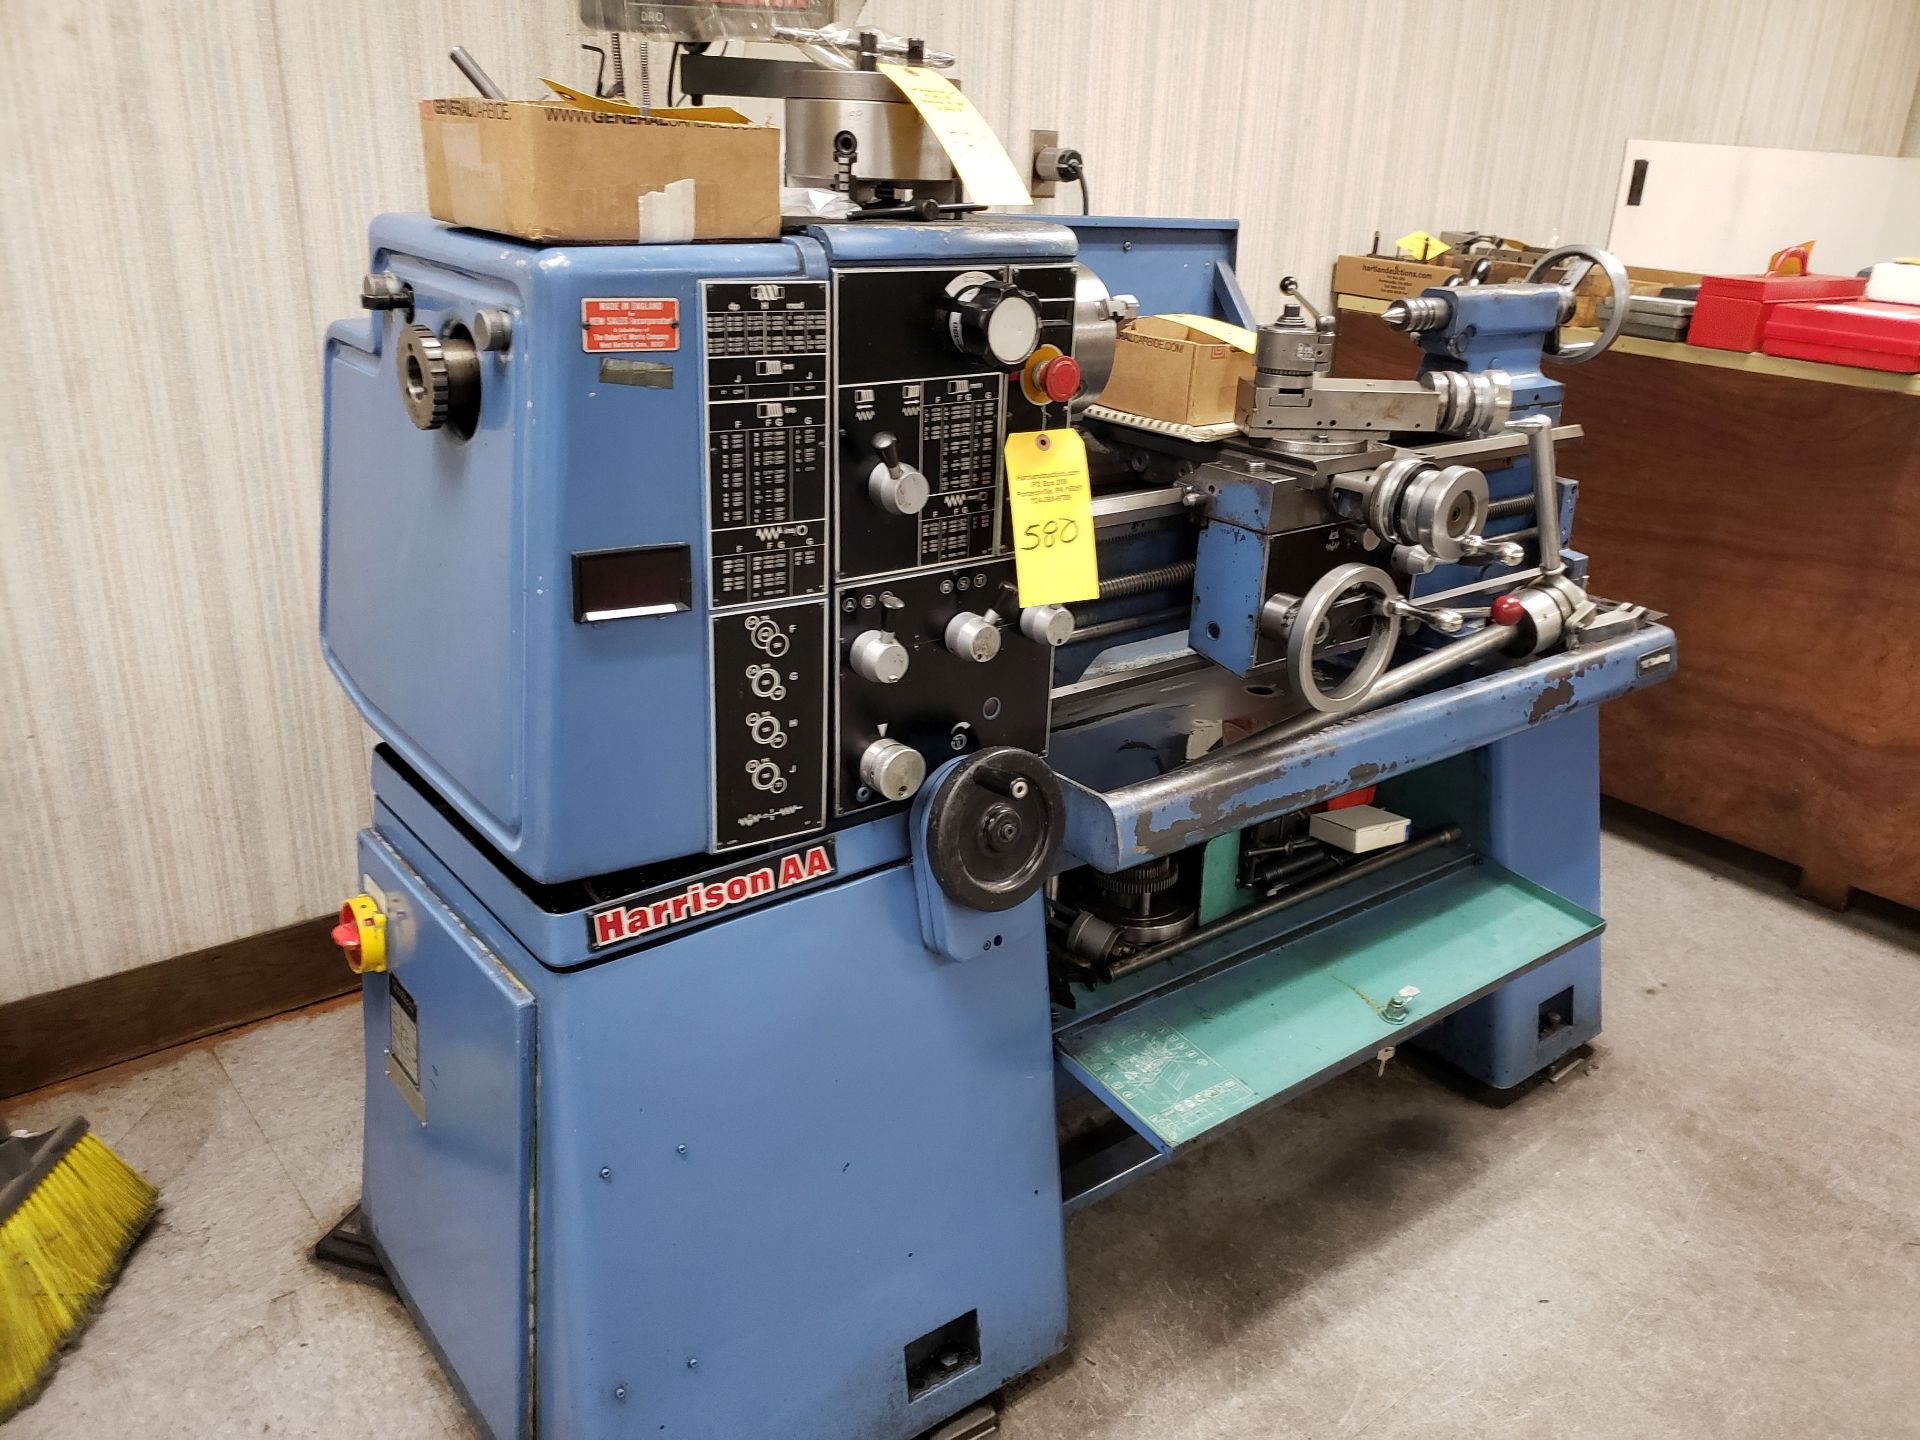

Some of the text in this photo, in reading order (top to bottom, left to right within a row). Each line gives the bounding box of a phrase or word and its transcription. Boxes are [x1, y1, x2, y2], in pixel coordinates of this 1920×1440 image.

[640, 11, 664, 22] DRO
[599, 302, 620, 310] MADE
[631, 302, 663, 310] ENGLAND
[1020, 518, 1078, 550] 580
[593, 845, 835, 946] Harrison AA
